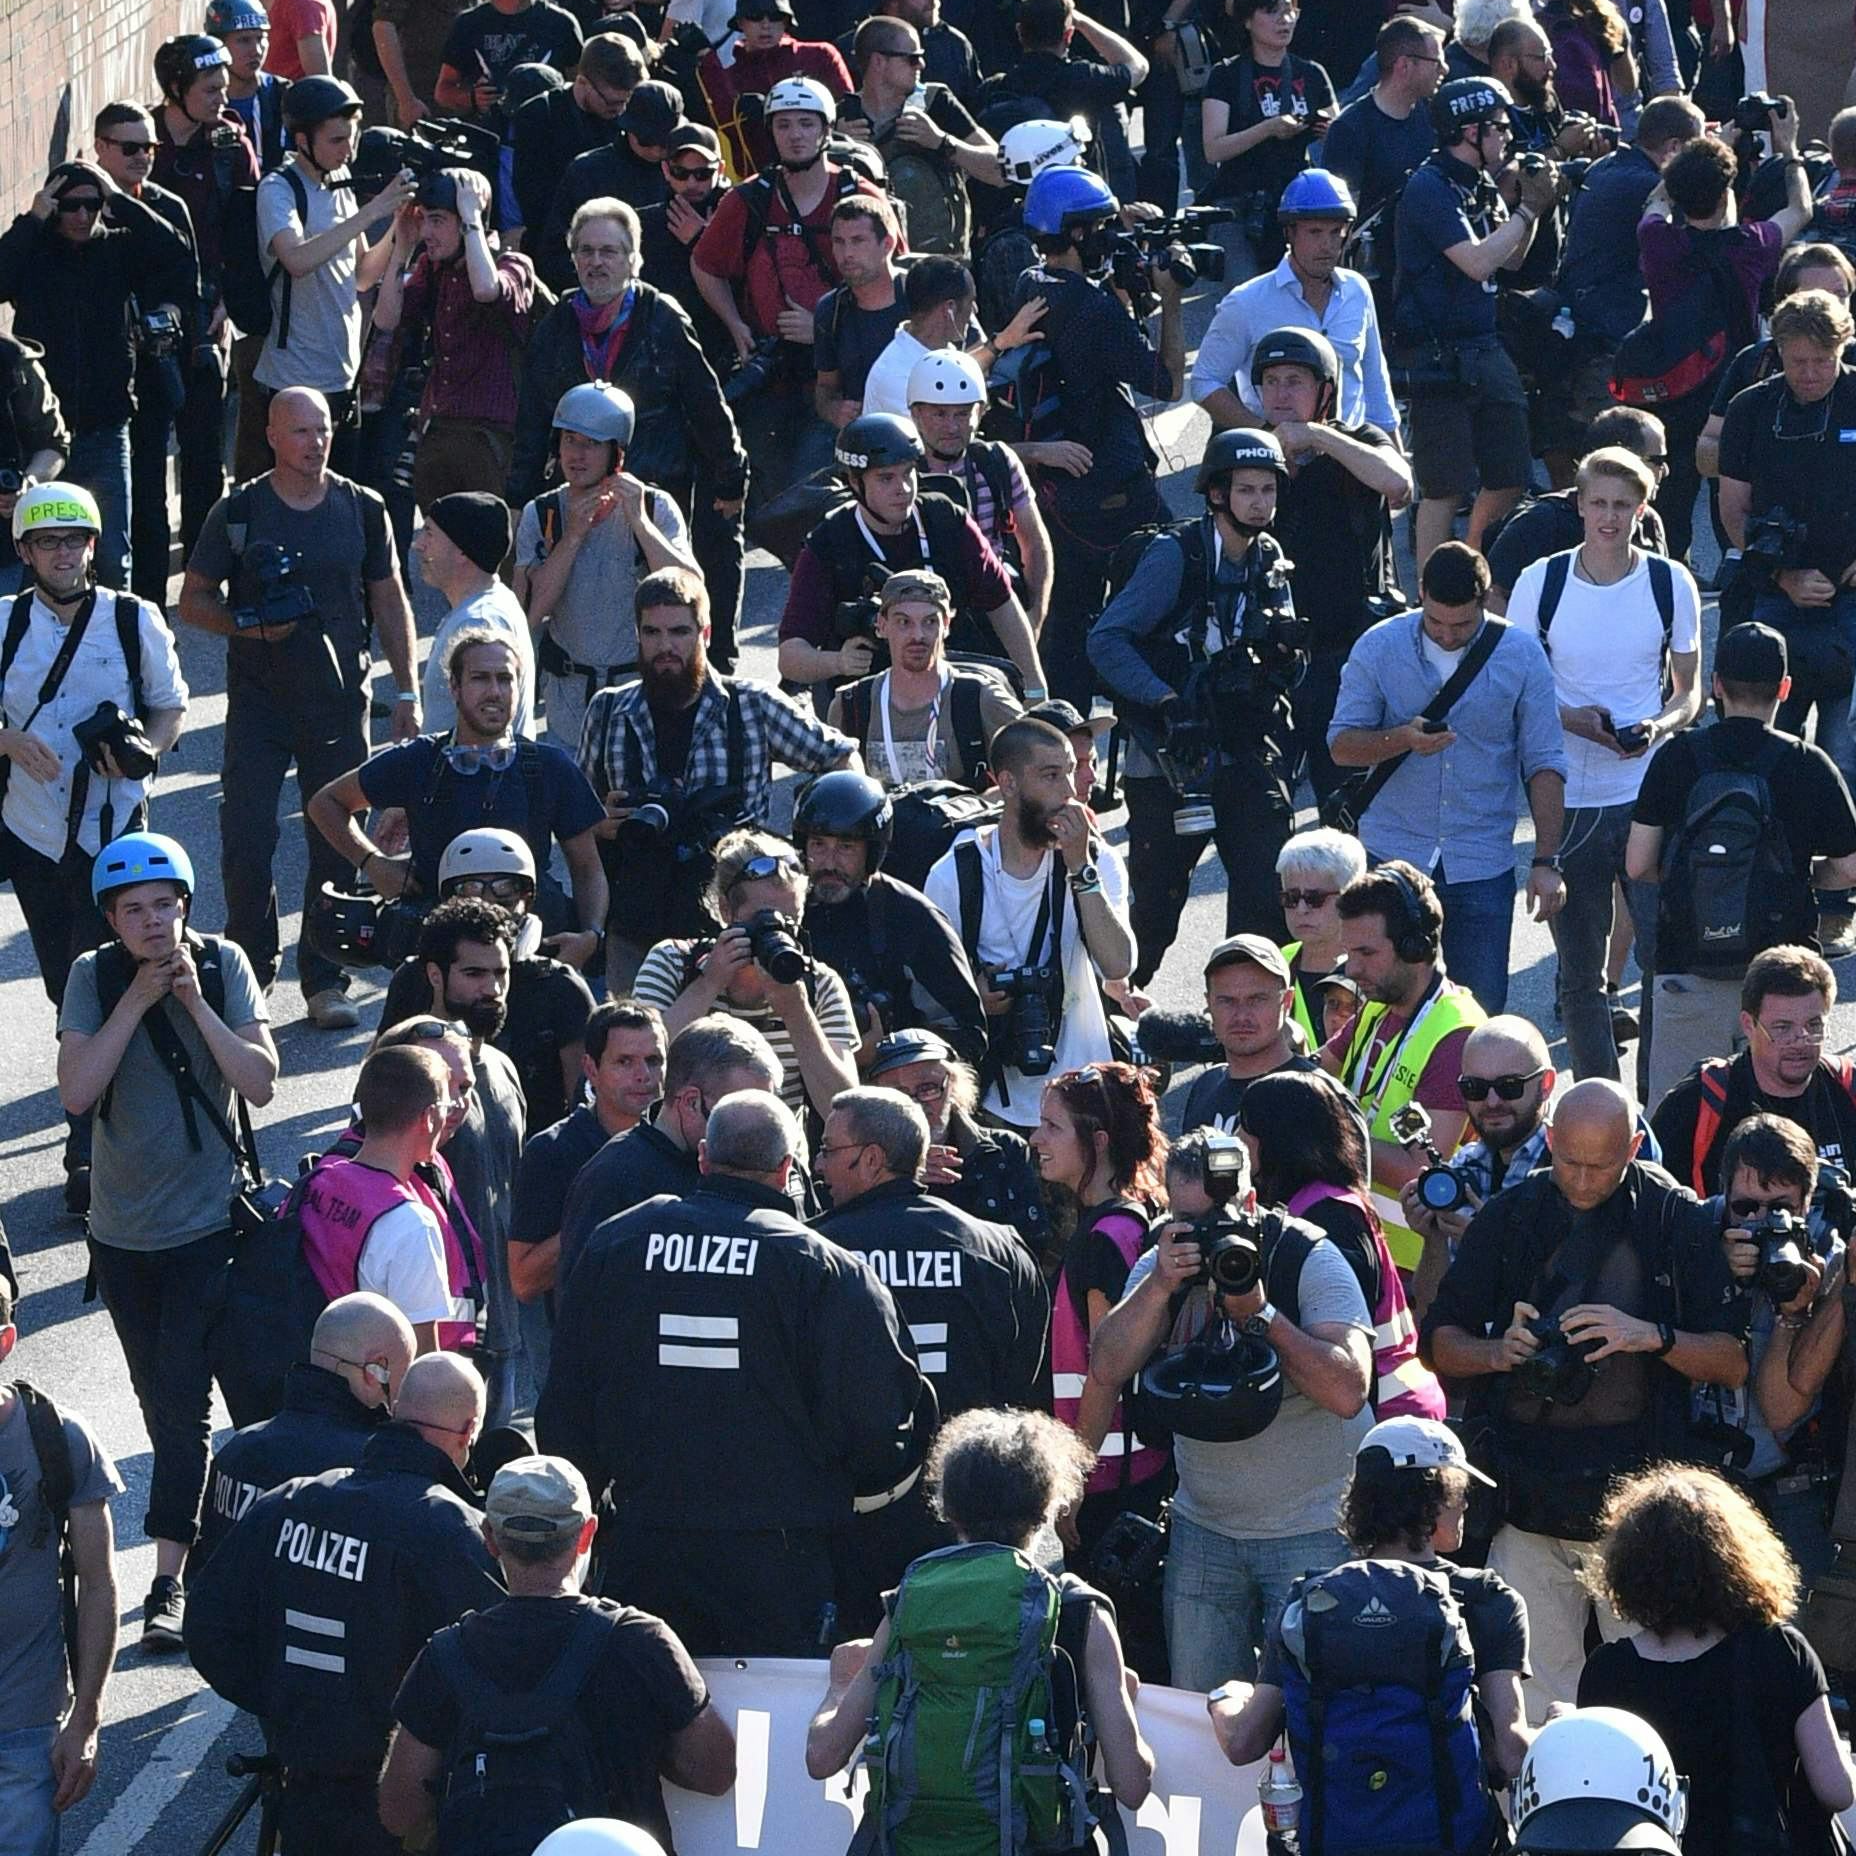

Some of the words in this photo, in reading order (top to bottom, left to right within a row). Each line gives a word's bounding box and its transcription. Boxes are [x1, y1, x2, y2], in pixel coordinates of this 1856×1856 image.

[1449, 89, 1495, 116] PRESS
[30, 501, 91, 523] PRESS
[645, 1233, 758, 1276] POLIZEI
[275, 1519, 368, 1582] POLIZEI
[1643, 1754, 1673, 1790] 14
